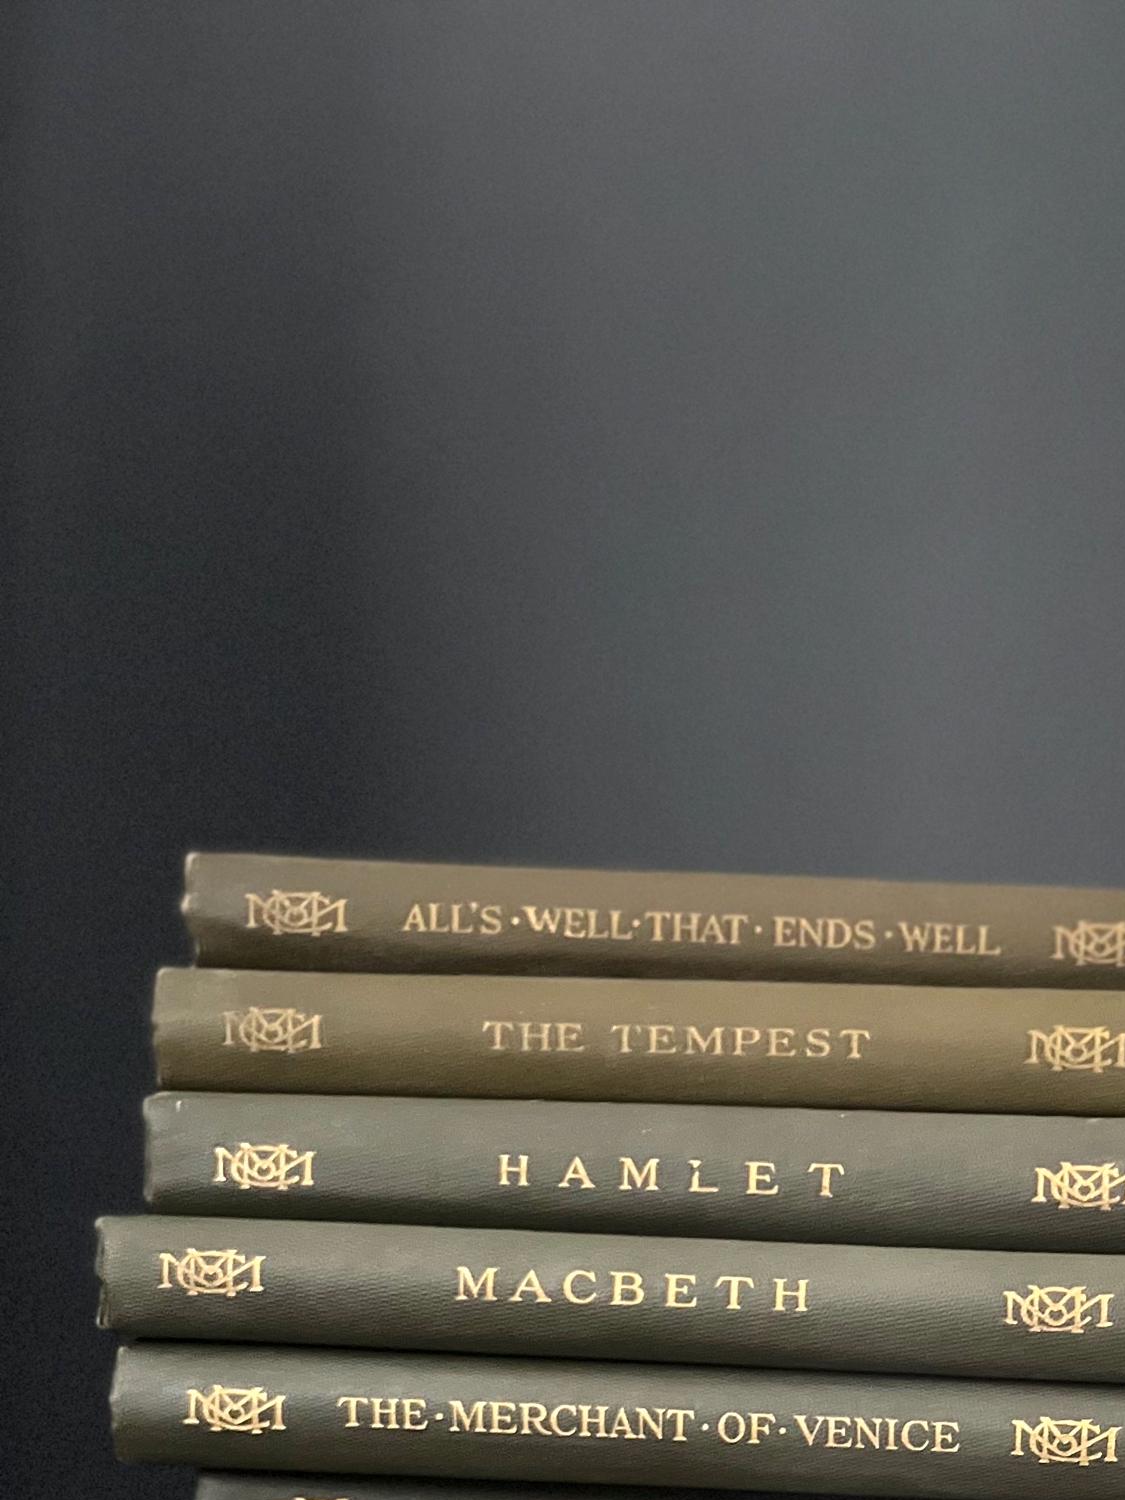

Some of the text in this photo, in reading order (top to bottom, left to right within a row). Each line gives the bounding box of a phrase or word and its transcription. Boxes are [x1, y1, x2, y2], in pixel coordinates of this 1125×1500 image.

[403, 901, 1001, 956] ALL'S WELL THAT ENDS WELL
[483, 1020, 871, 1060] THE TEMPEST
[499, 1154, 845, 1198] HAMLET
[456, 1265, 810, 1312] MACBETH
[337, 1395, 961, 1453] THE MERCHANT OF VENICE
